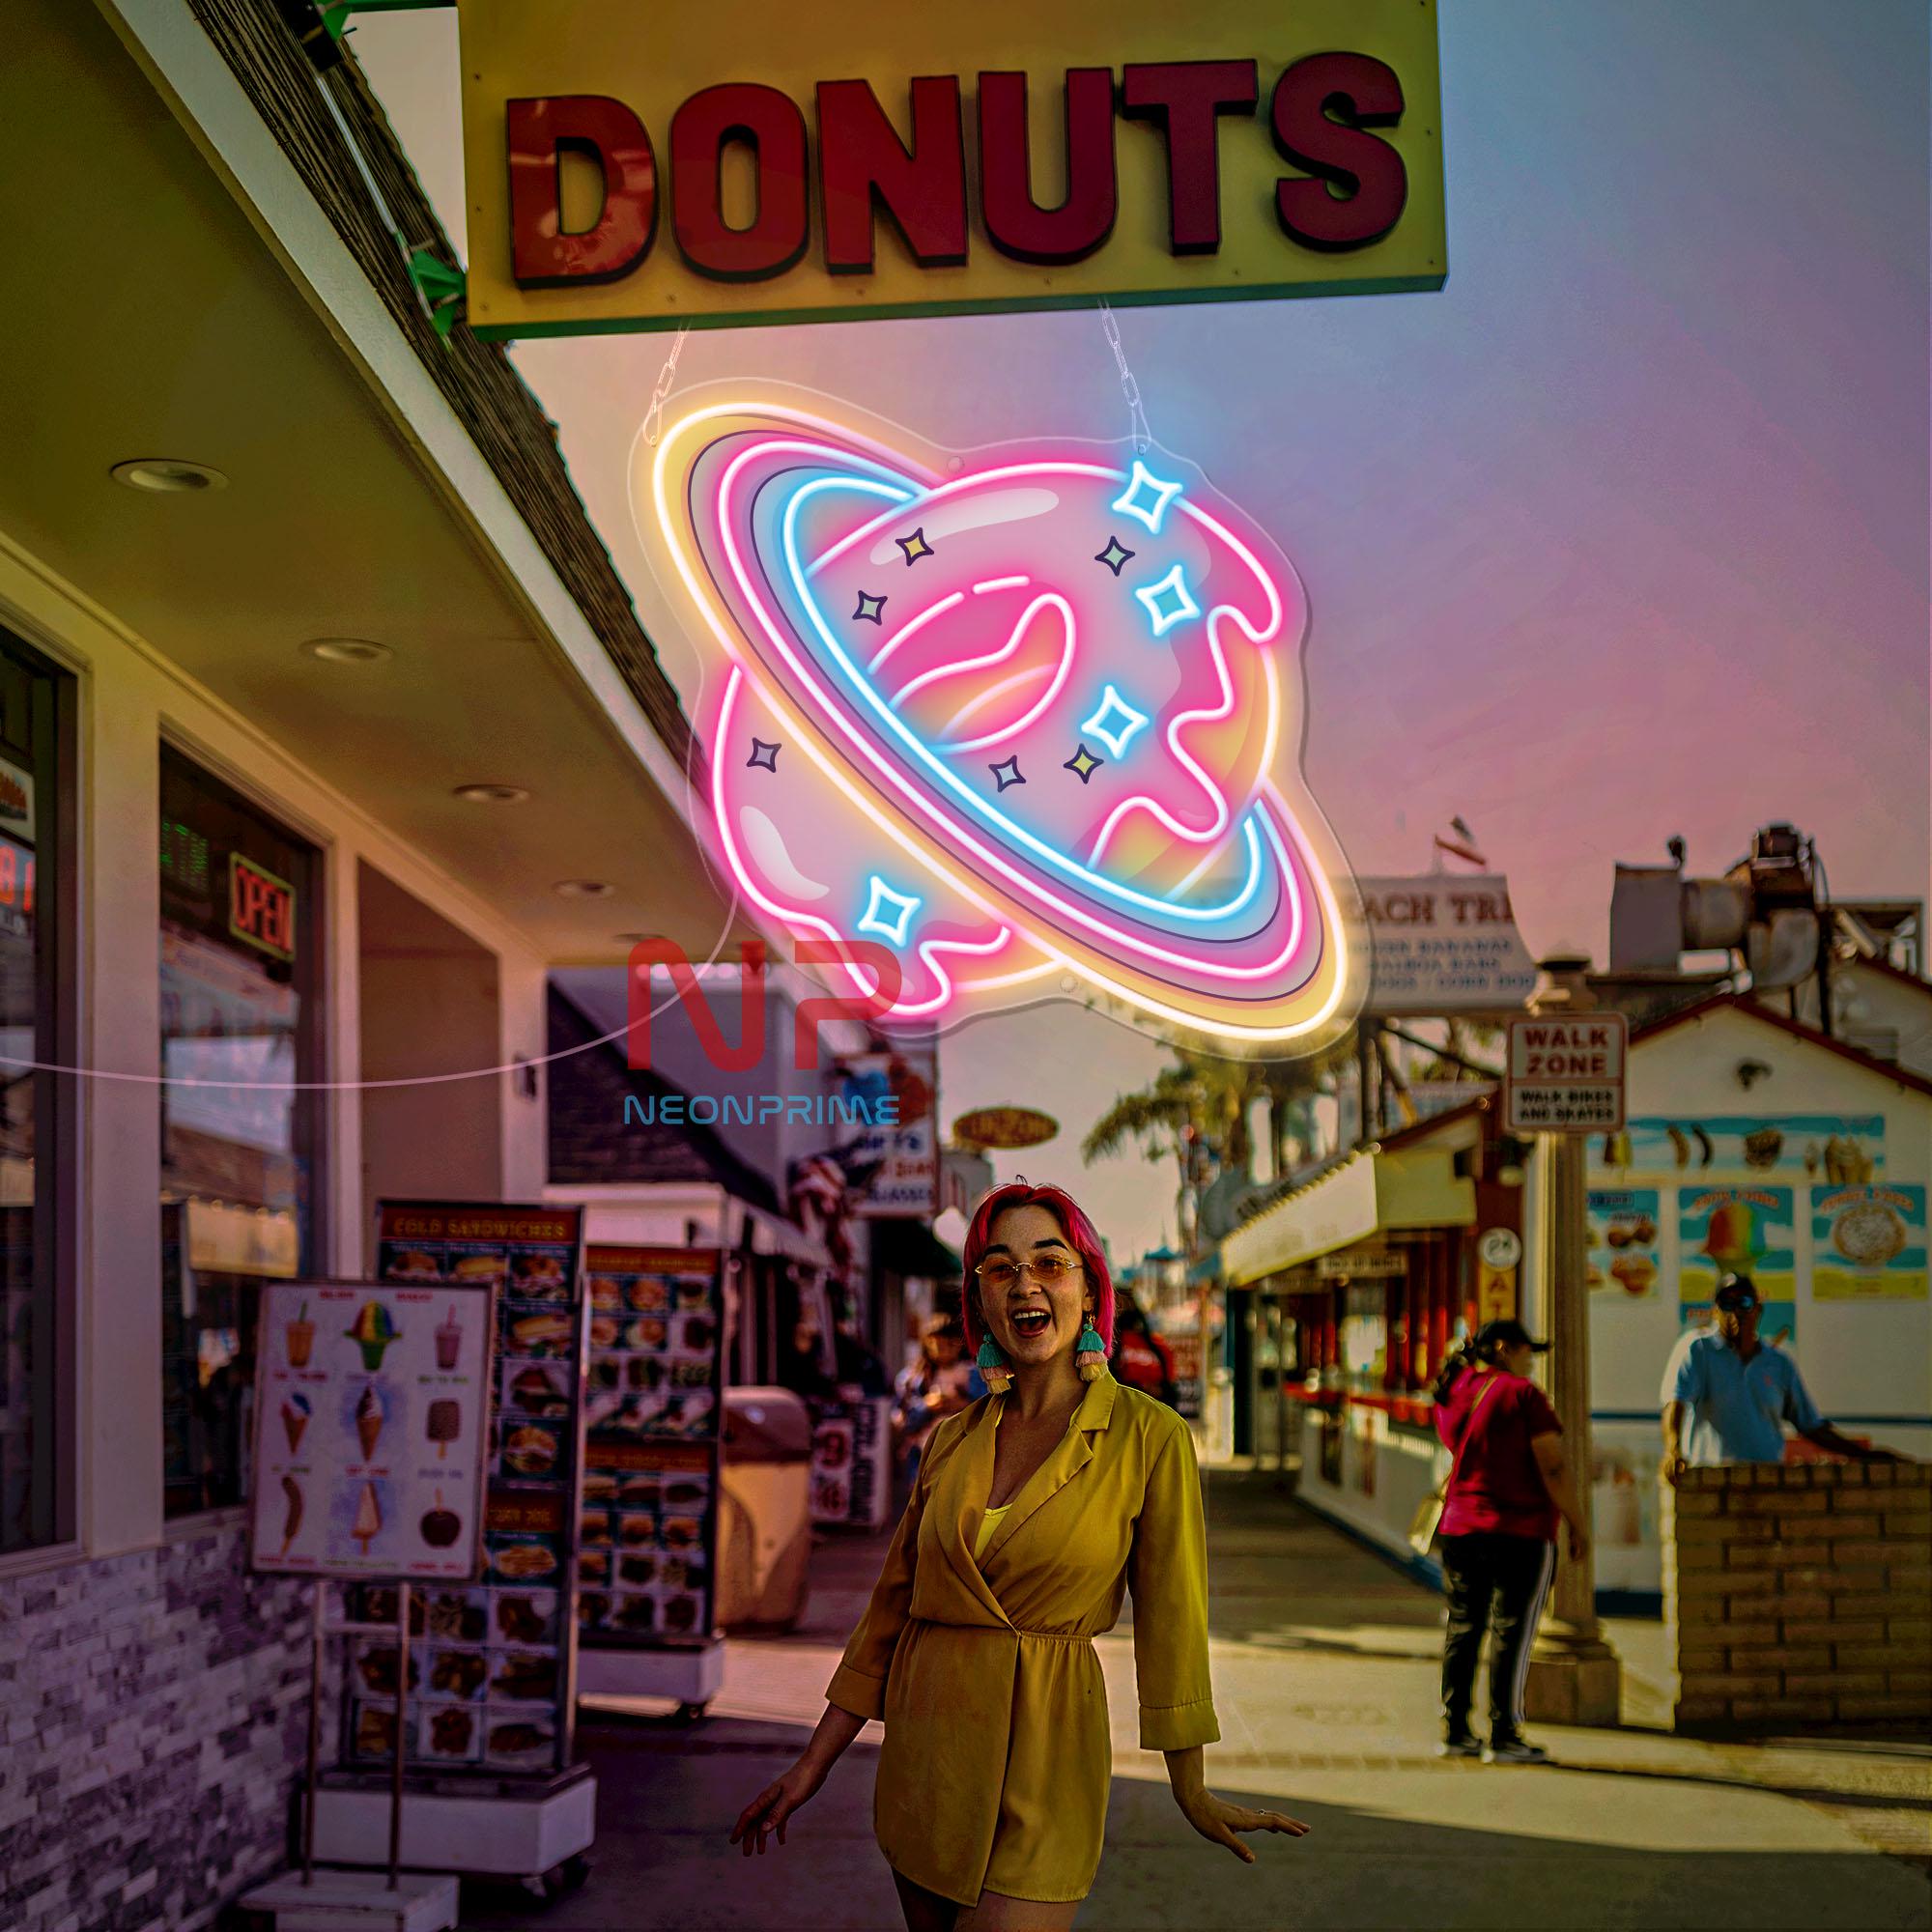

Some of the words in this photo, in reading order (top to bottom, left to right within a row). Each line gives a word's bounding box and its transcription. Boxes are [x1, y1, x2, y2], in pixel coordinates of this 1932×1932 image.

[505, 51, 1407, 289] DONUTS
[235, 864, 293, 956] OPEN
[1523, 1027, 1608, 1049] WALK
[1526, 1051, 1606, 1075] ZONE
[1520, 1090, 1562, 1104] WALK
[1567, 1090, 1613, 1104] BIKES
[1520, 1107, 1551, 1122] AND
[1554, 1107, 1614, 1122] SKATES
[393, 1217, 442, 1236] COLD
[446, 1219, 568, 1238] SANDWICHES
